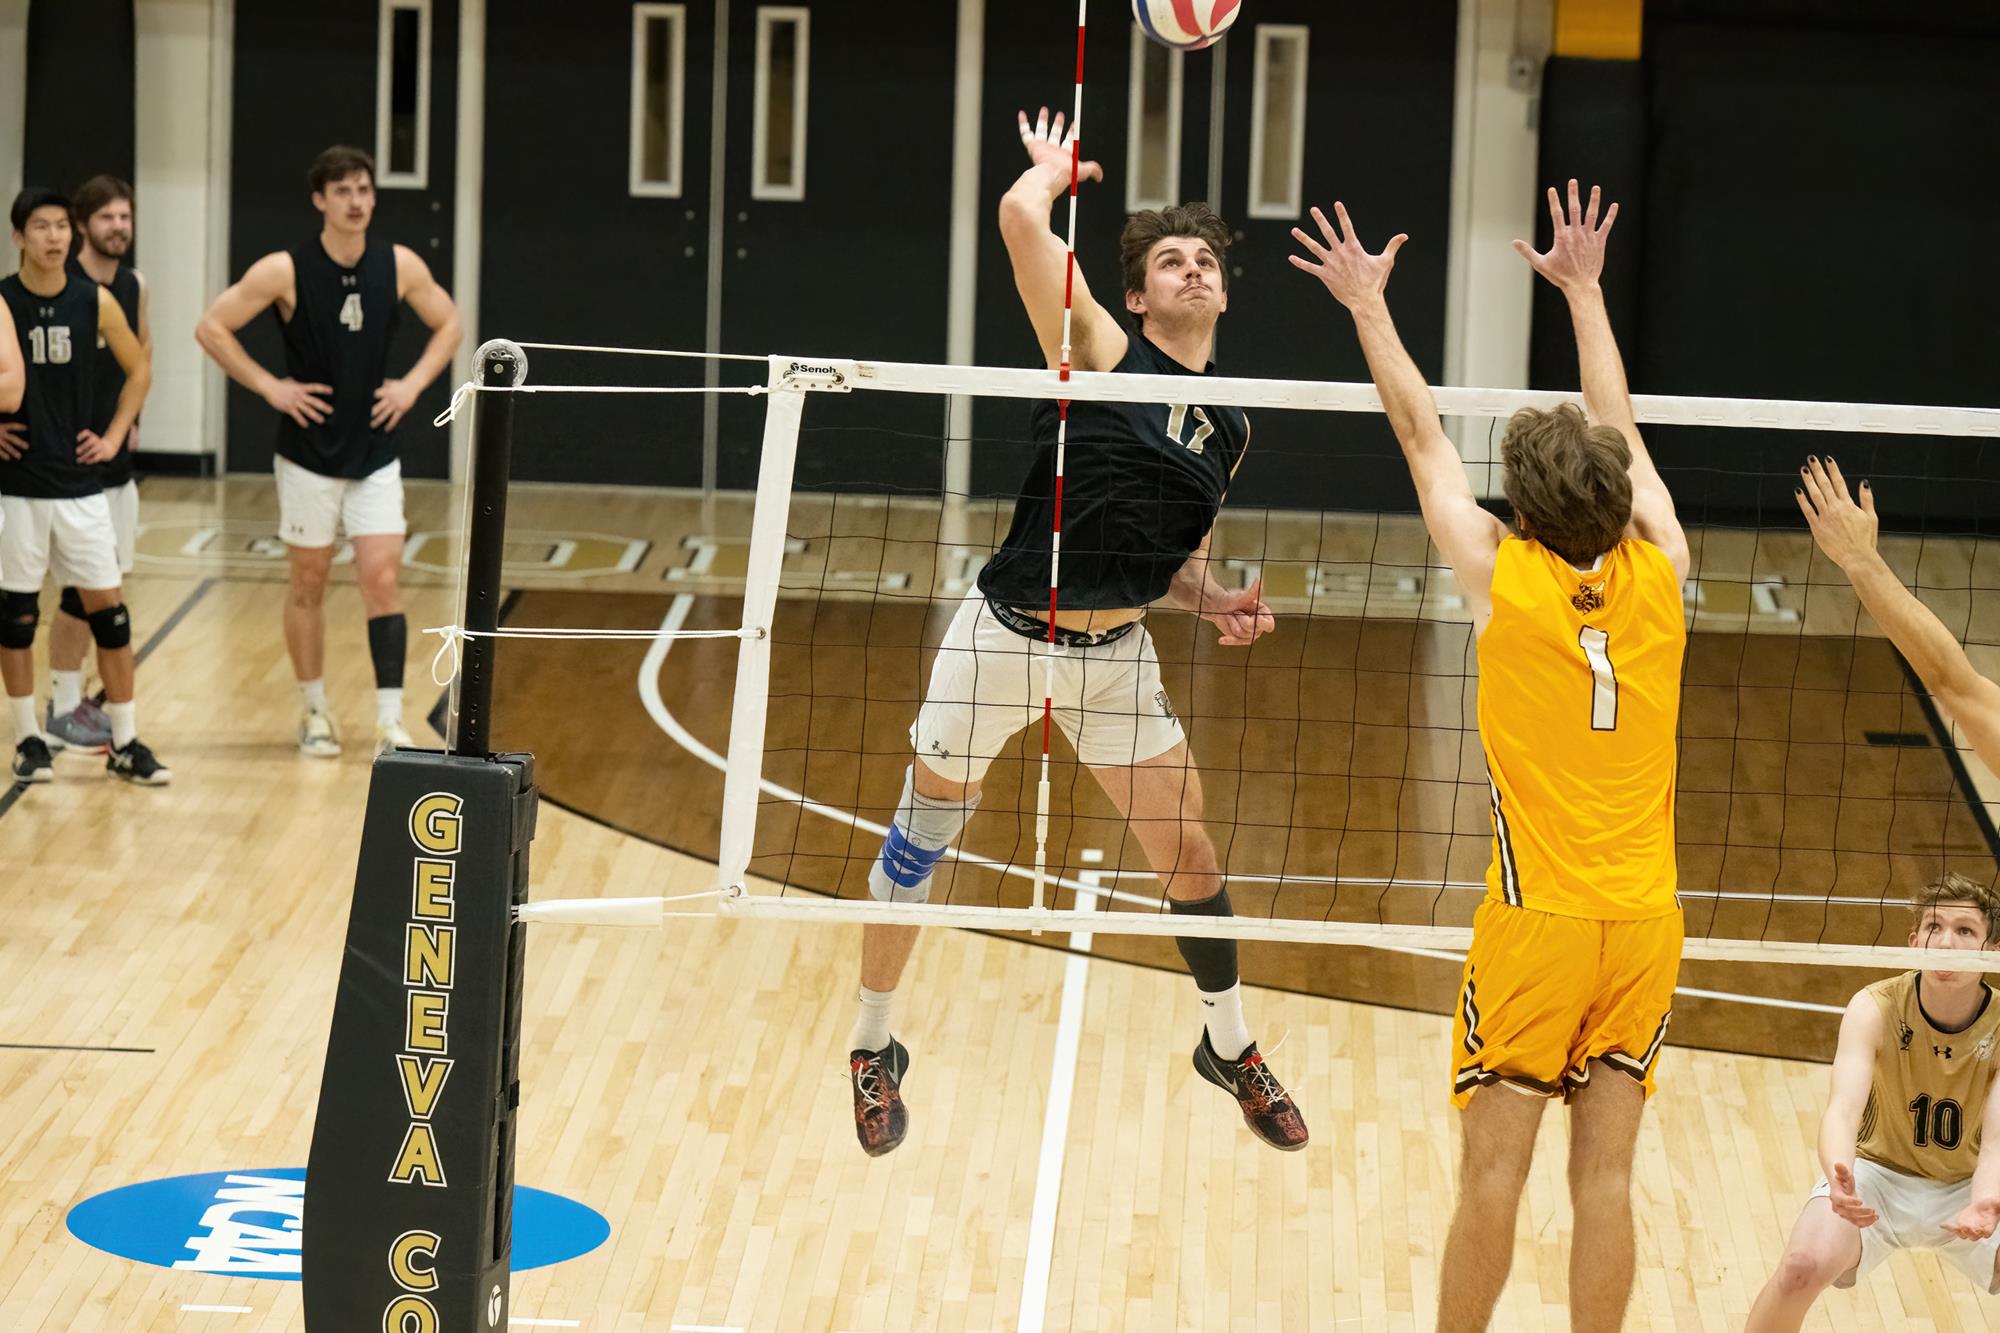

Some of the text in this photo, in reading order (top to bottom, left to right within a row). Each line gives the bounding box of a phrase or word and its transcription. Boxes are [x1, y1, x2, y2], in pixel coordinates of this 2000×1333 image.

[339, 293, 364, 332] 4
[28, 326, 72, 364] 15
[800, 364, 837, 374] Senoh
[1578, 624, 1619, 732] 1
[387, 791, 465, 1188] GENEVA
[1909, 1093, 1963, 1150] 10
[171, 1174, 306, 1273] NCAA
